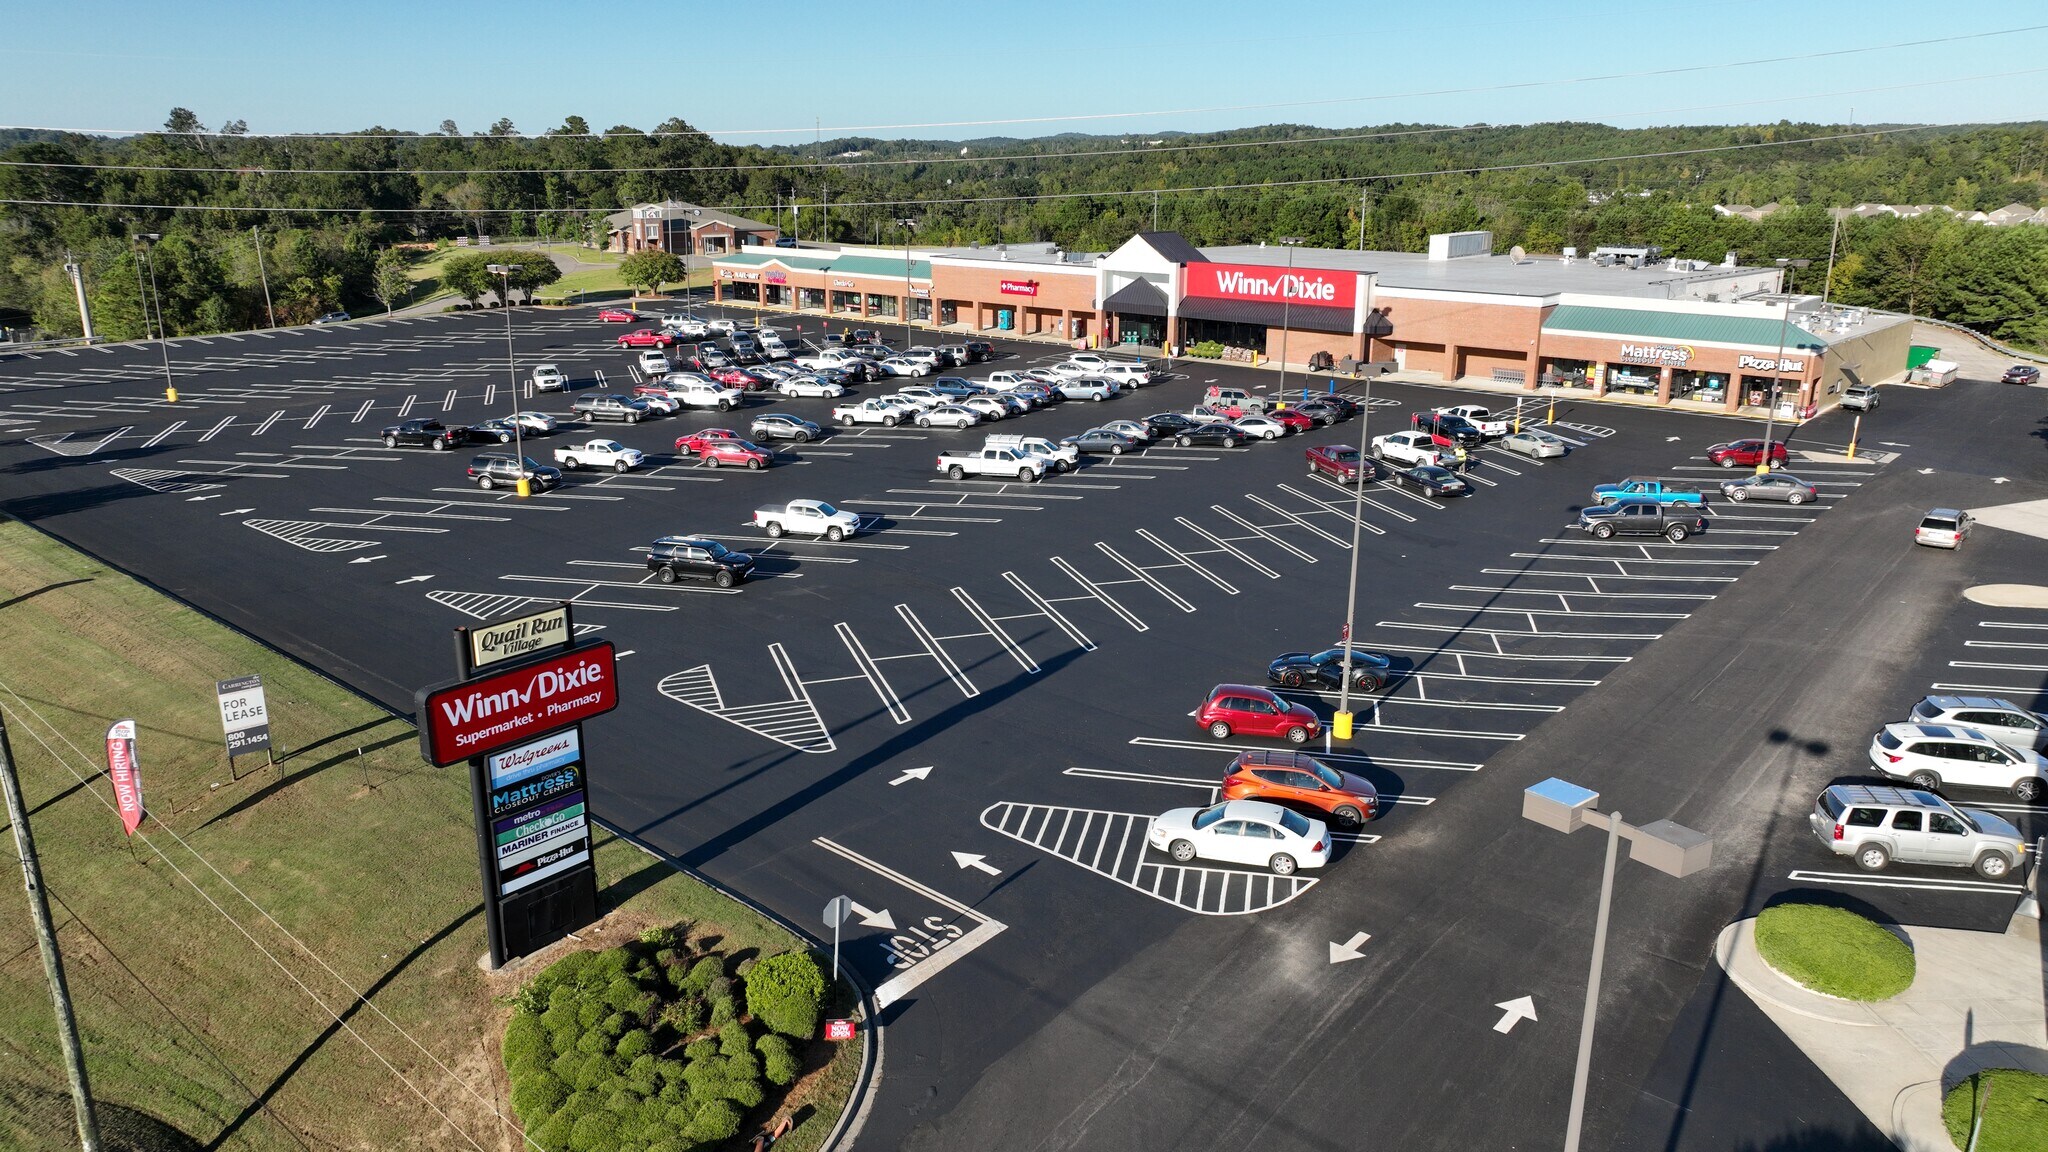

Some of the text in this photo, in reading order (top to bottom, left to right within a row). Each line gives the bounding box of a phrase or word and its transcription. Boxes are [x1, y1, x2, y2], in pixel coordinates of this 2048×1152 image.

[1007, 283, 1034, 294] Pharmacy
[1216, 271, 1335, 300] Winn Dixie
[1621, 344, 1688, 361] Mattress
[1738, 355, 1804, 372] Pizza Hut
[482, 617, 563, 652] Quail Run
[503, 637, 542, 655] Village
[223, 698, 247, 710] FOR
[442, 661, 602, 727] Winn Dixie
[225, 706, 263, 722] LEASE
[455, 691, 602, 747] Supermarket Pharmacy
[227, 731, 245, 741] 800
[229, 733, 268, 749] 291.1454
[111, 741, 129, 782] HIRING
[499, 739, 570, 770] Walgreens
[506, 772, 522, 781] drive
[523, 768, 535, 776] thru
[118, 784, 135, 812] NOW
[493, 771, 575, 808] Mattress
[494, 793, 539, 814] CLOSEOUT
[543, 782, 574, 796] CENTER
[514, 810, 541, 824] metro
[516, 812, 566, 838] Check Go
[501, 820, 579, 855] MARINER FINANCE
[537, 845, 574, 867] Pizza Hut
